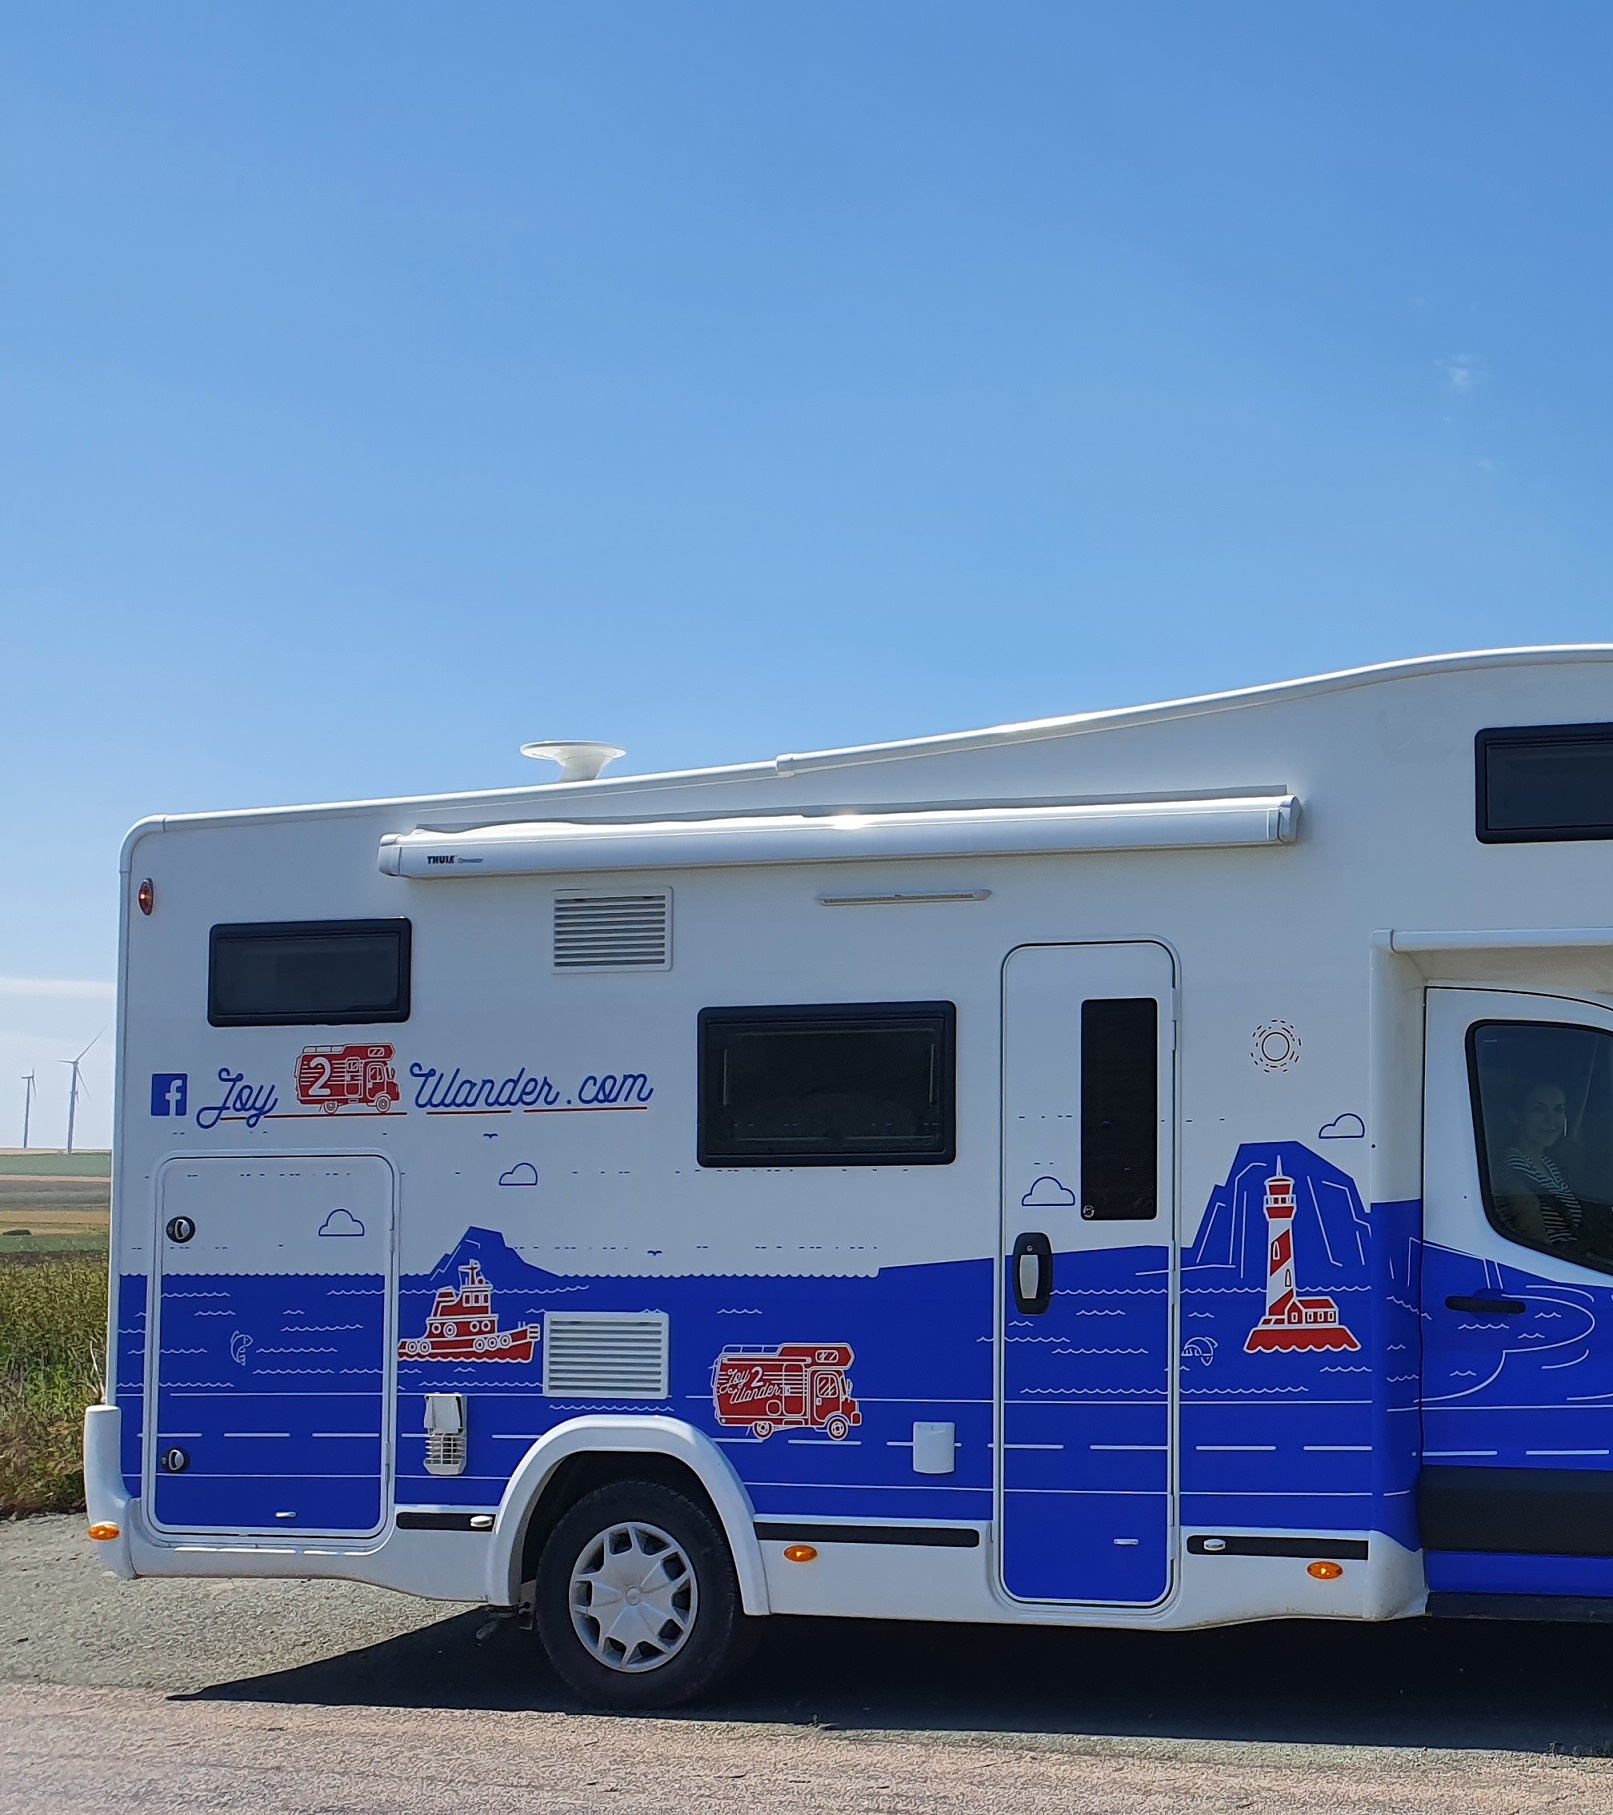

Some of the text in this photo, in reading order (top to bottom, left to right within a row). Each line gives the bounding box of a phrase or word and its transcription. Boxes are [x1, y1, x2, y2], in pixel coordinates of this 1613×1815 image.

[427, 855, 455, 864] THULE
[196, 1067, 279, 1128] Joy
[307, 1056, 332, 1096] 2
[719, 1366, 764, 1394] Joy 2
